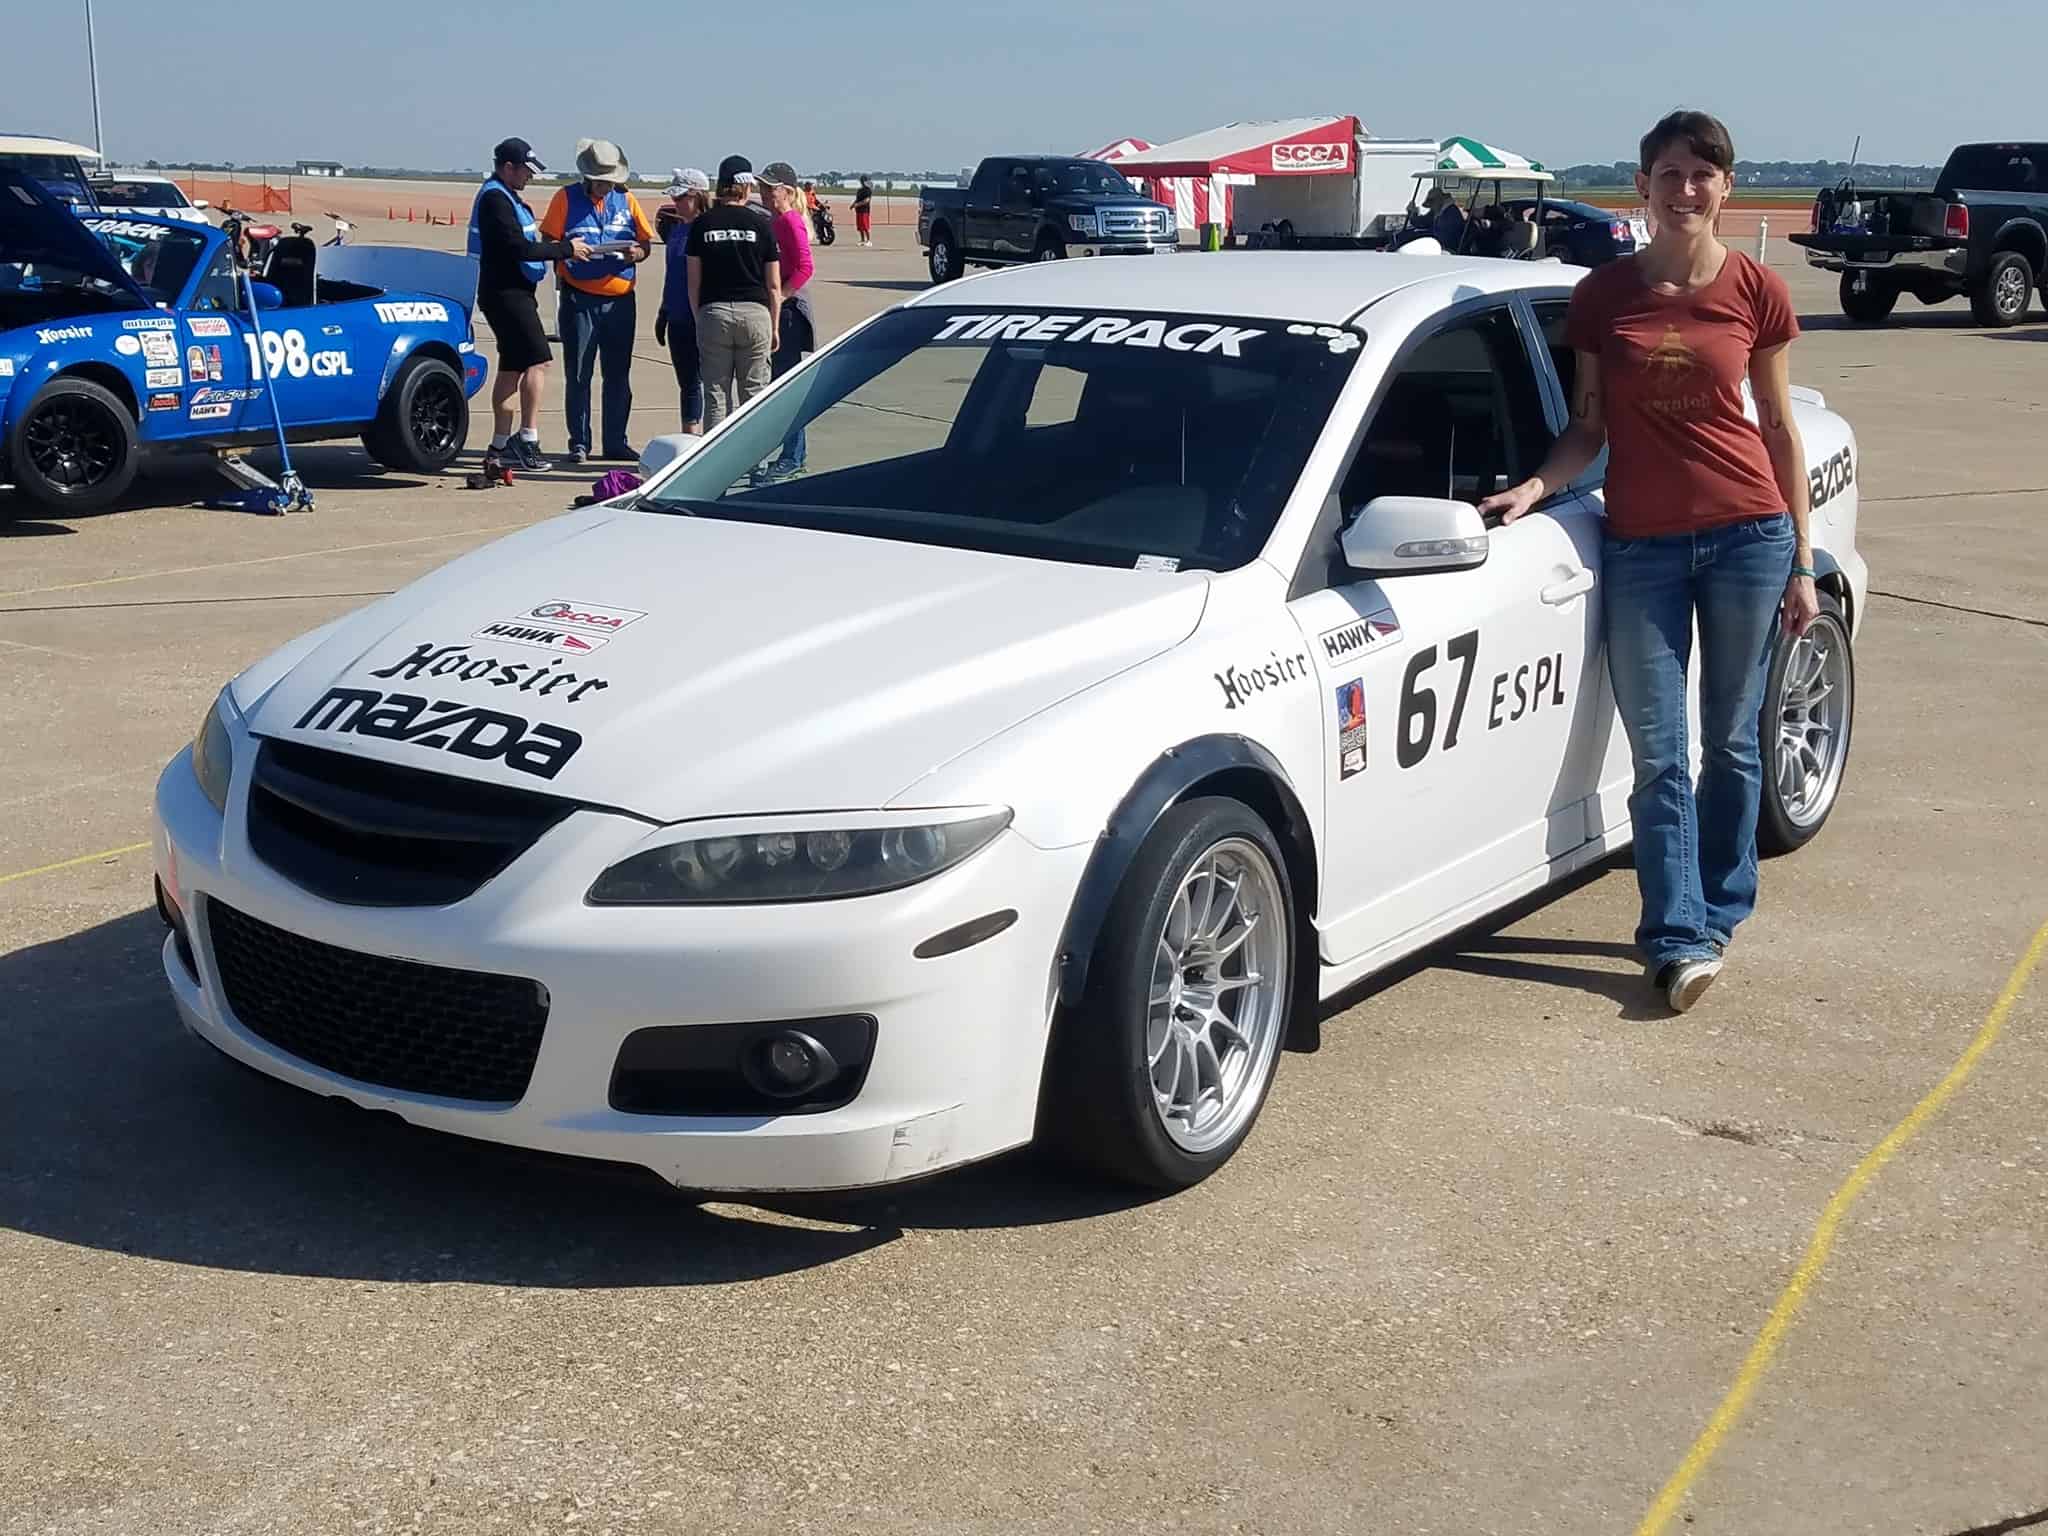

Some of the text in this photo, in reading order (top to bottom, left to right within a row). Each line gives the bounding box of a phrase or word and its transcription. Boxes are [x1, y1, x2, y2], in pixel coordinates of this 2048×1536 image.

[1275, 145, 1344, 161] SCCA
[373, 302, 449, 323] mazda
[243, 329, 309, 380] 198
[312, 351, 353, 376] CSPL
[1808, 445, 1853, 512] azda
[482, 624, 564, 644] HAWK
[1324, 620, 1376, 658] HAWK
[368, 643, 608, 703] Hoosier
[1214, 650, 1309, 709] Hoosier
[1396, 629, 1565, 769] 67 ESPL
[293, 687, 583, 780] mazda
